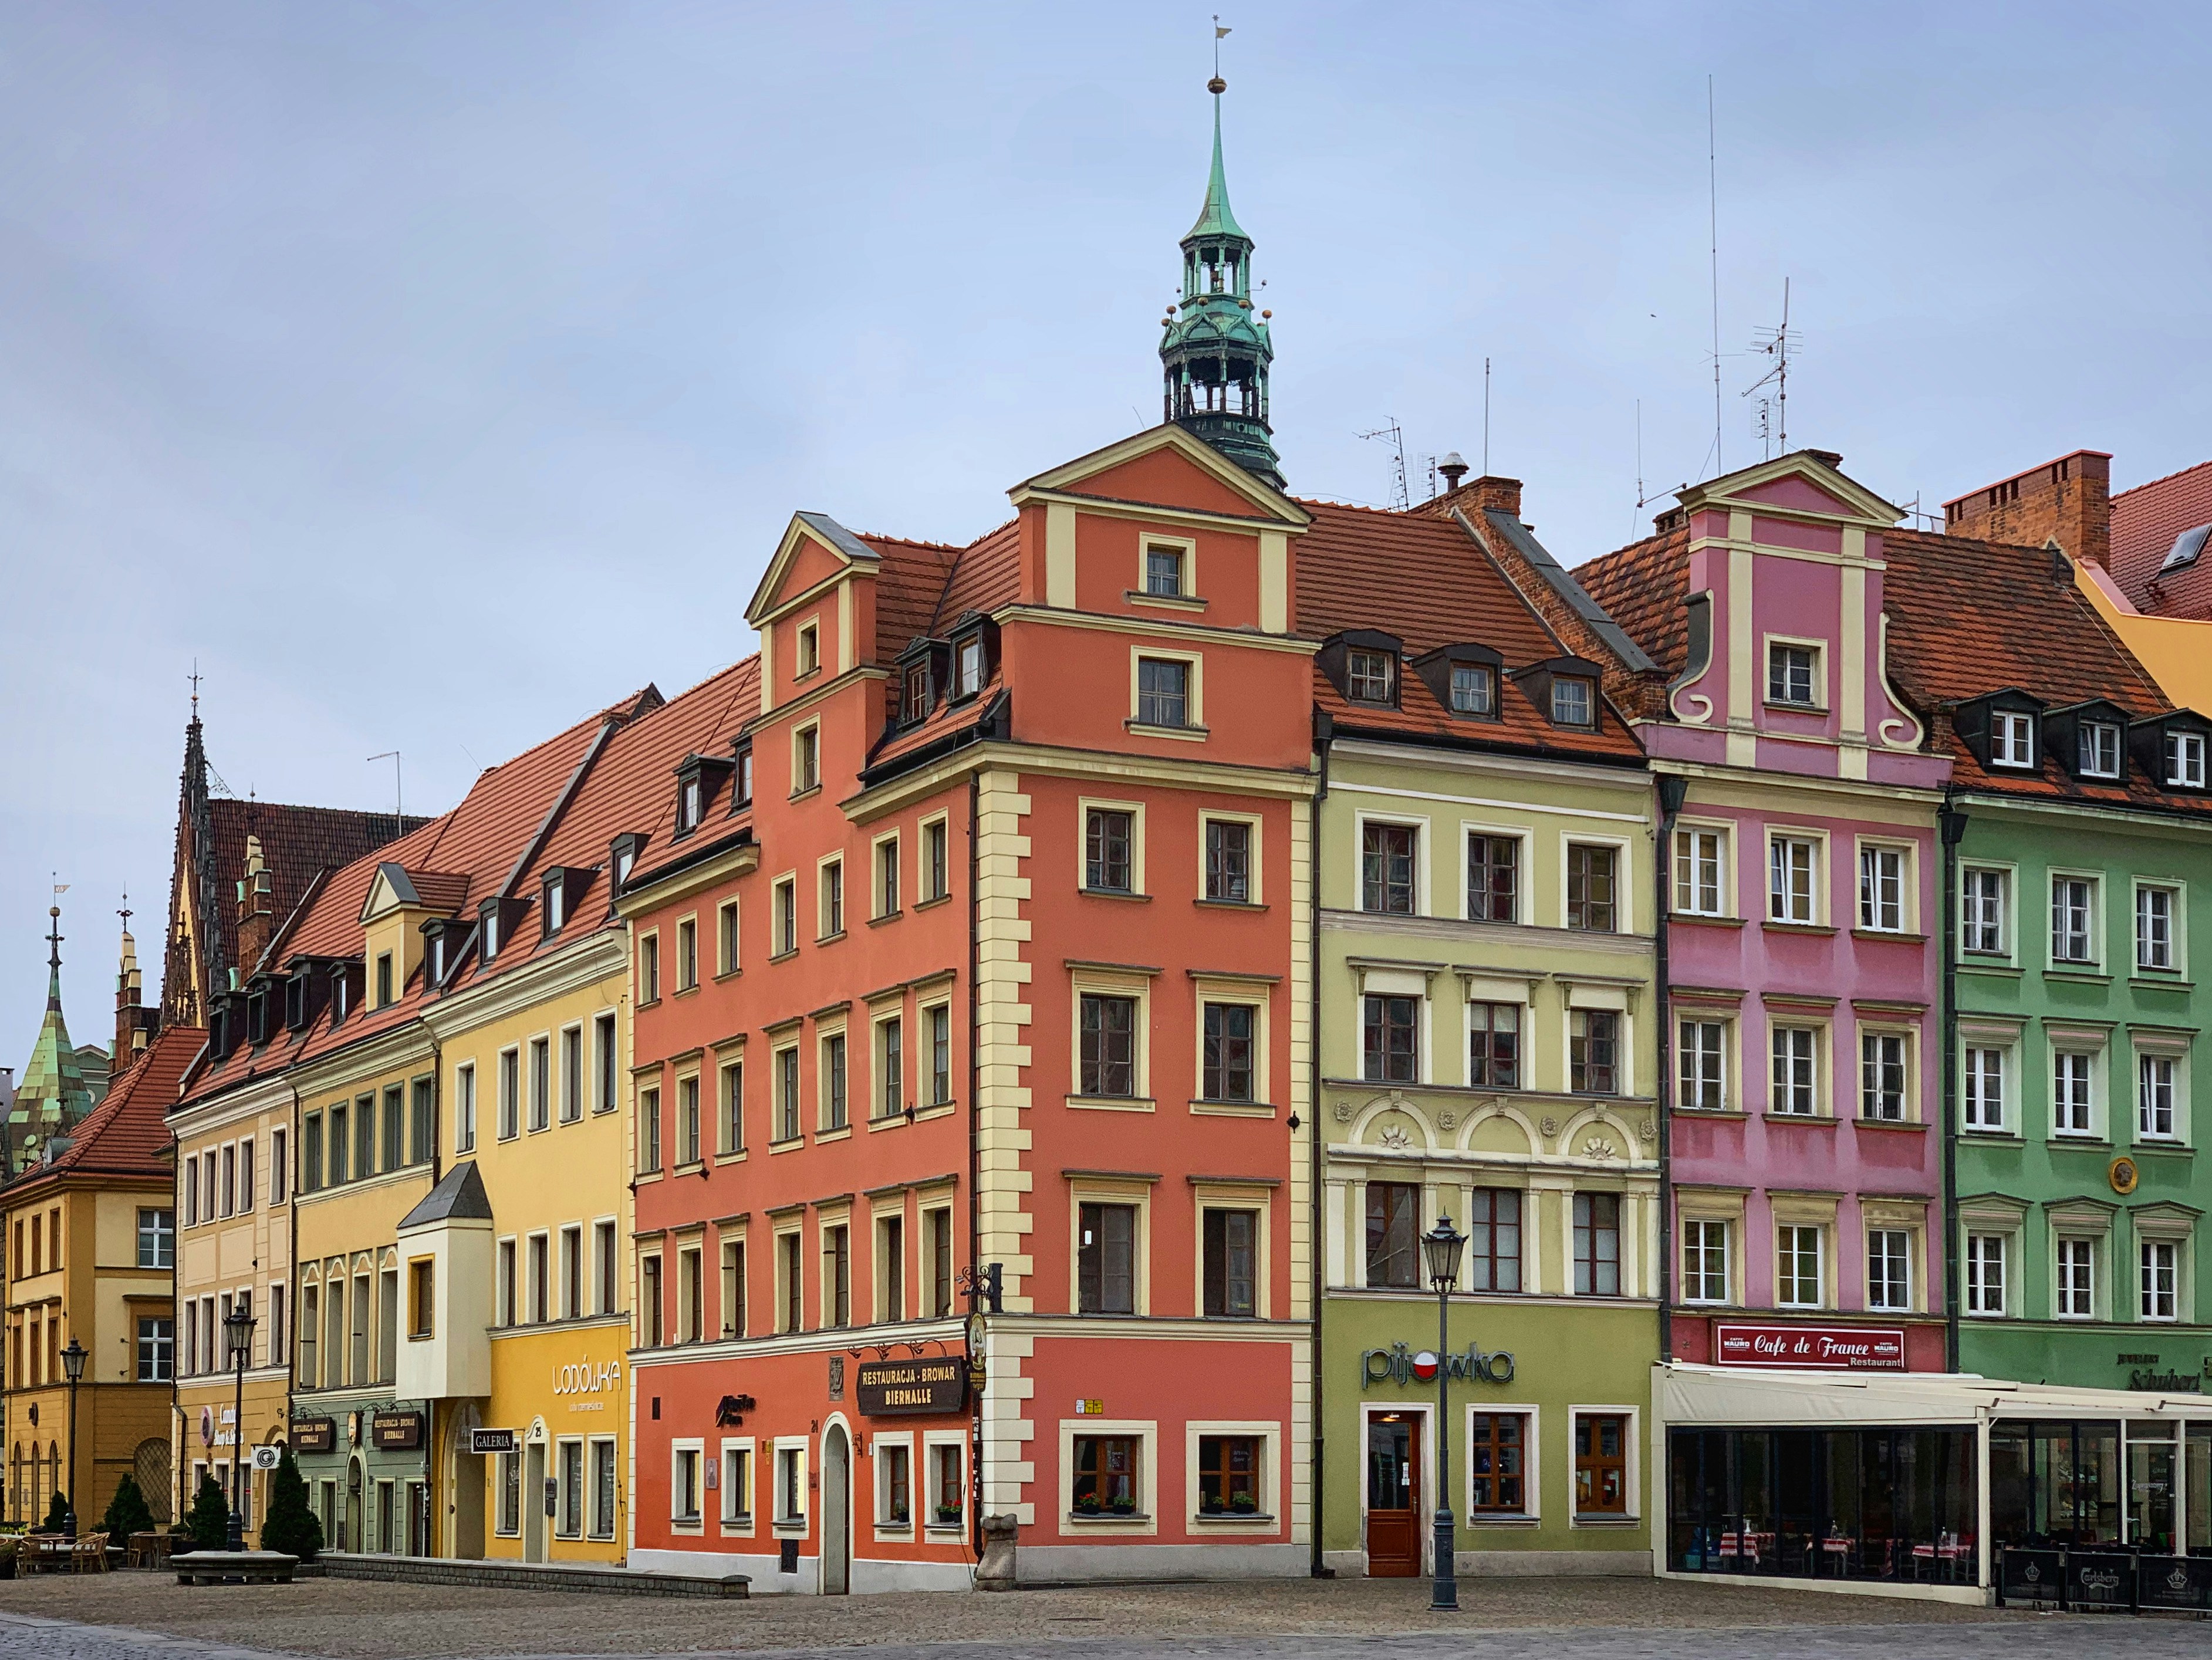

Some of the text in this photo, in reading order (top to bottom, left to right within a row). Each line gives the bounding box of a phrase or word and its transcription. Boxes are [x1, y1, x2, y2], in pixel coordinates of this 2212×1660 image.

[1754, 1334, 1870, 1358] Cafe de France
[1362, 1341, 1514, 1390] pijawka
[1850, 1356, 1902, 1367] Restaurant
[553, 1354, 622, 1395] LODÓWKA
[863, 1366, 955, 1386] RESTAURACJA BROWAR
[885, 1388, 931, 1405] BIERHALLE
[475, 1435, 509, 1448] GALERIA
[2081, 1567, 2119, 1589] Carlsberg
